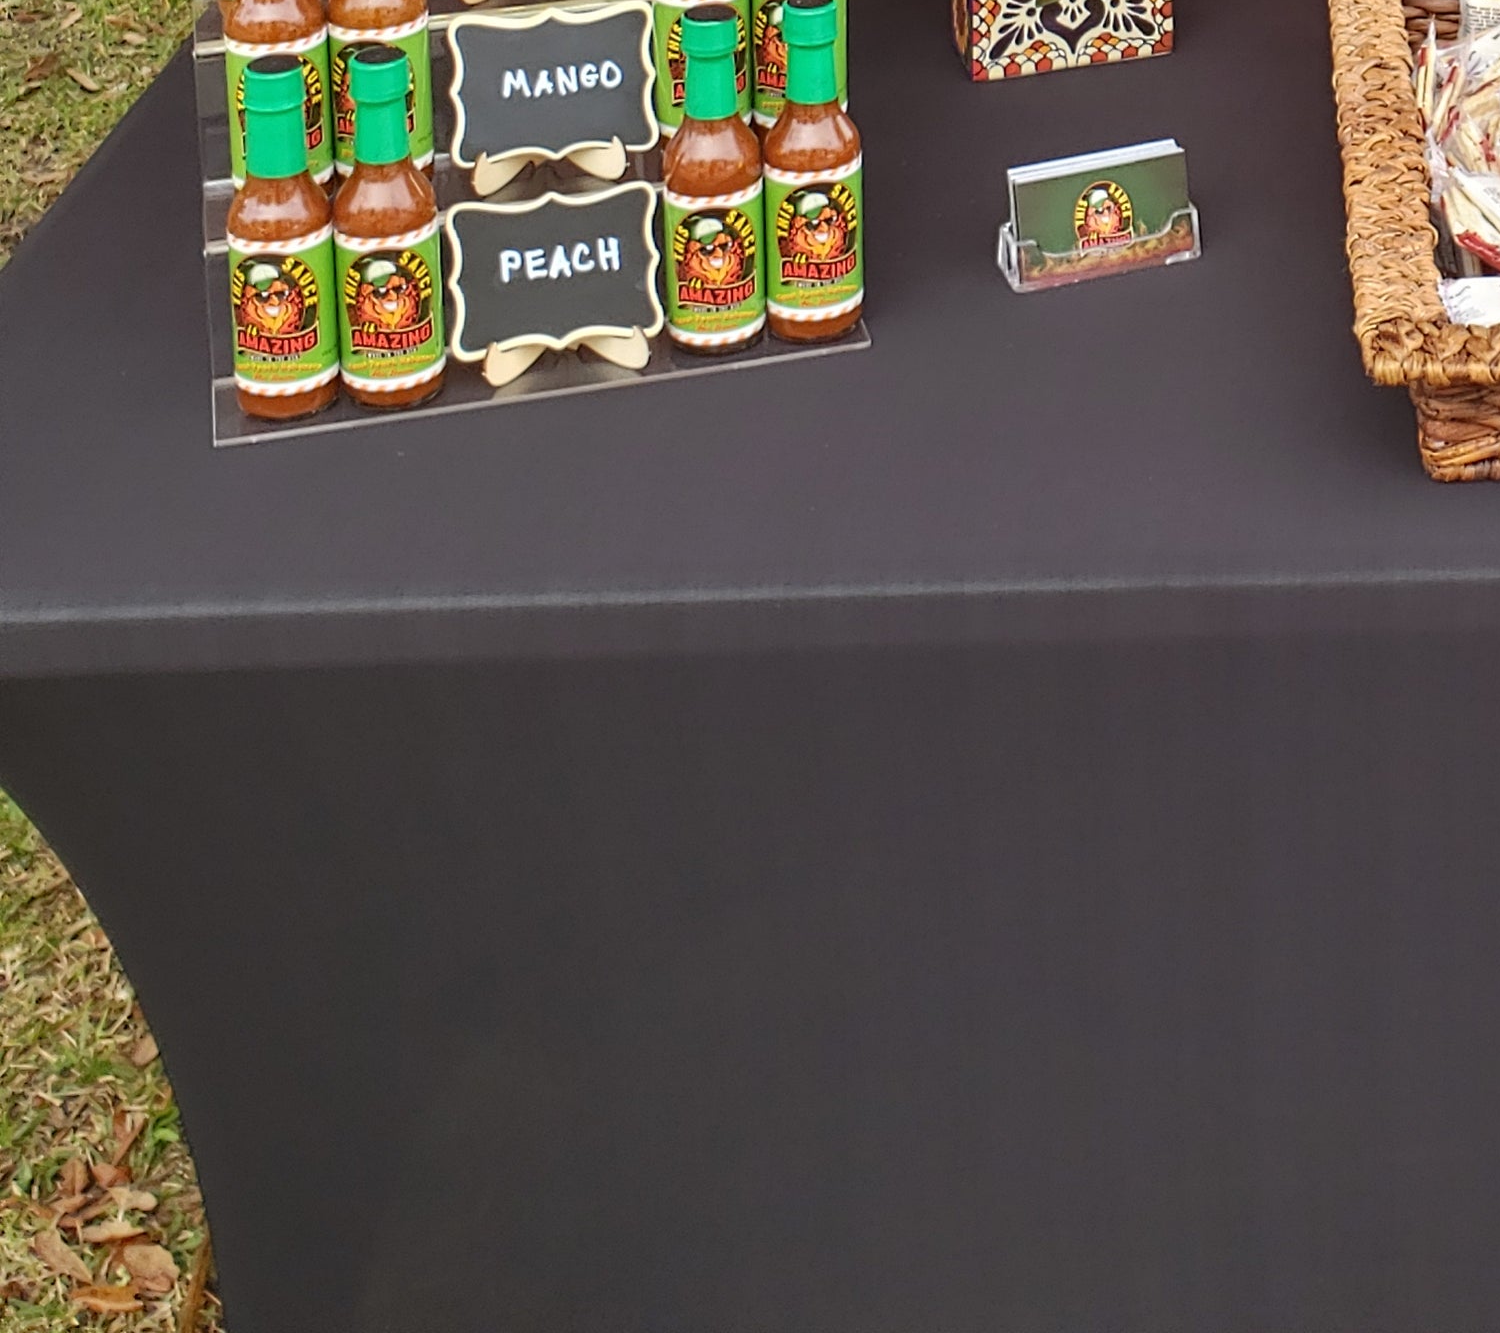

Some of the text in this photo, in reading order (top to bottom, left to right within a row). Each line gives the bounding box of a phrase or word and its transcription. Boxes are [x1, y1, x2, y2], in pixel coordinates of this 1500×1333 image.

[298, 56, 322, 104] AUCE
[502, 59, 623, 99] MANGO
[726, 209, 756, 257] SAUCE
[777, 184, 857, 237] THIS SAUCE
[281, 257, 318, 307] SAUCE
[344, 251, 432, 305] THIS SAUCE
[499, 236, 621, 283] PEACH
[239, 330, 316, 353] AMAZING
